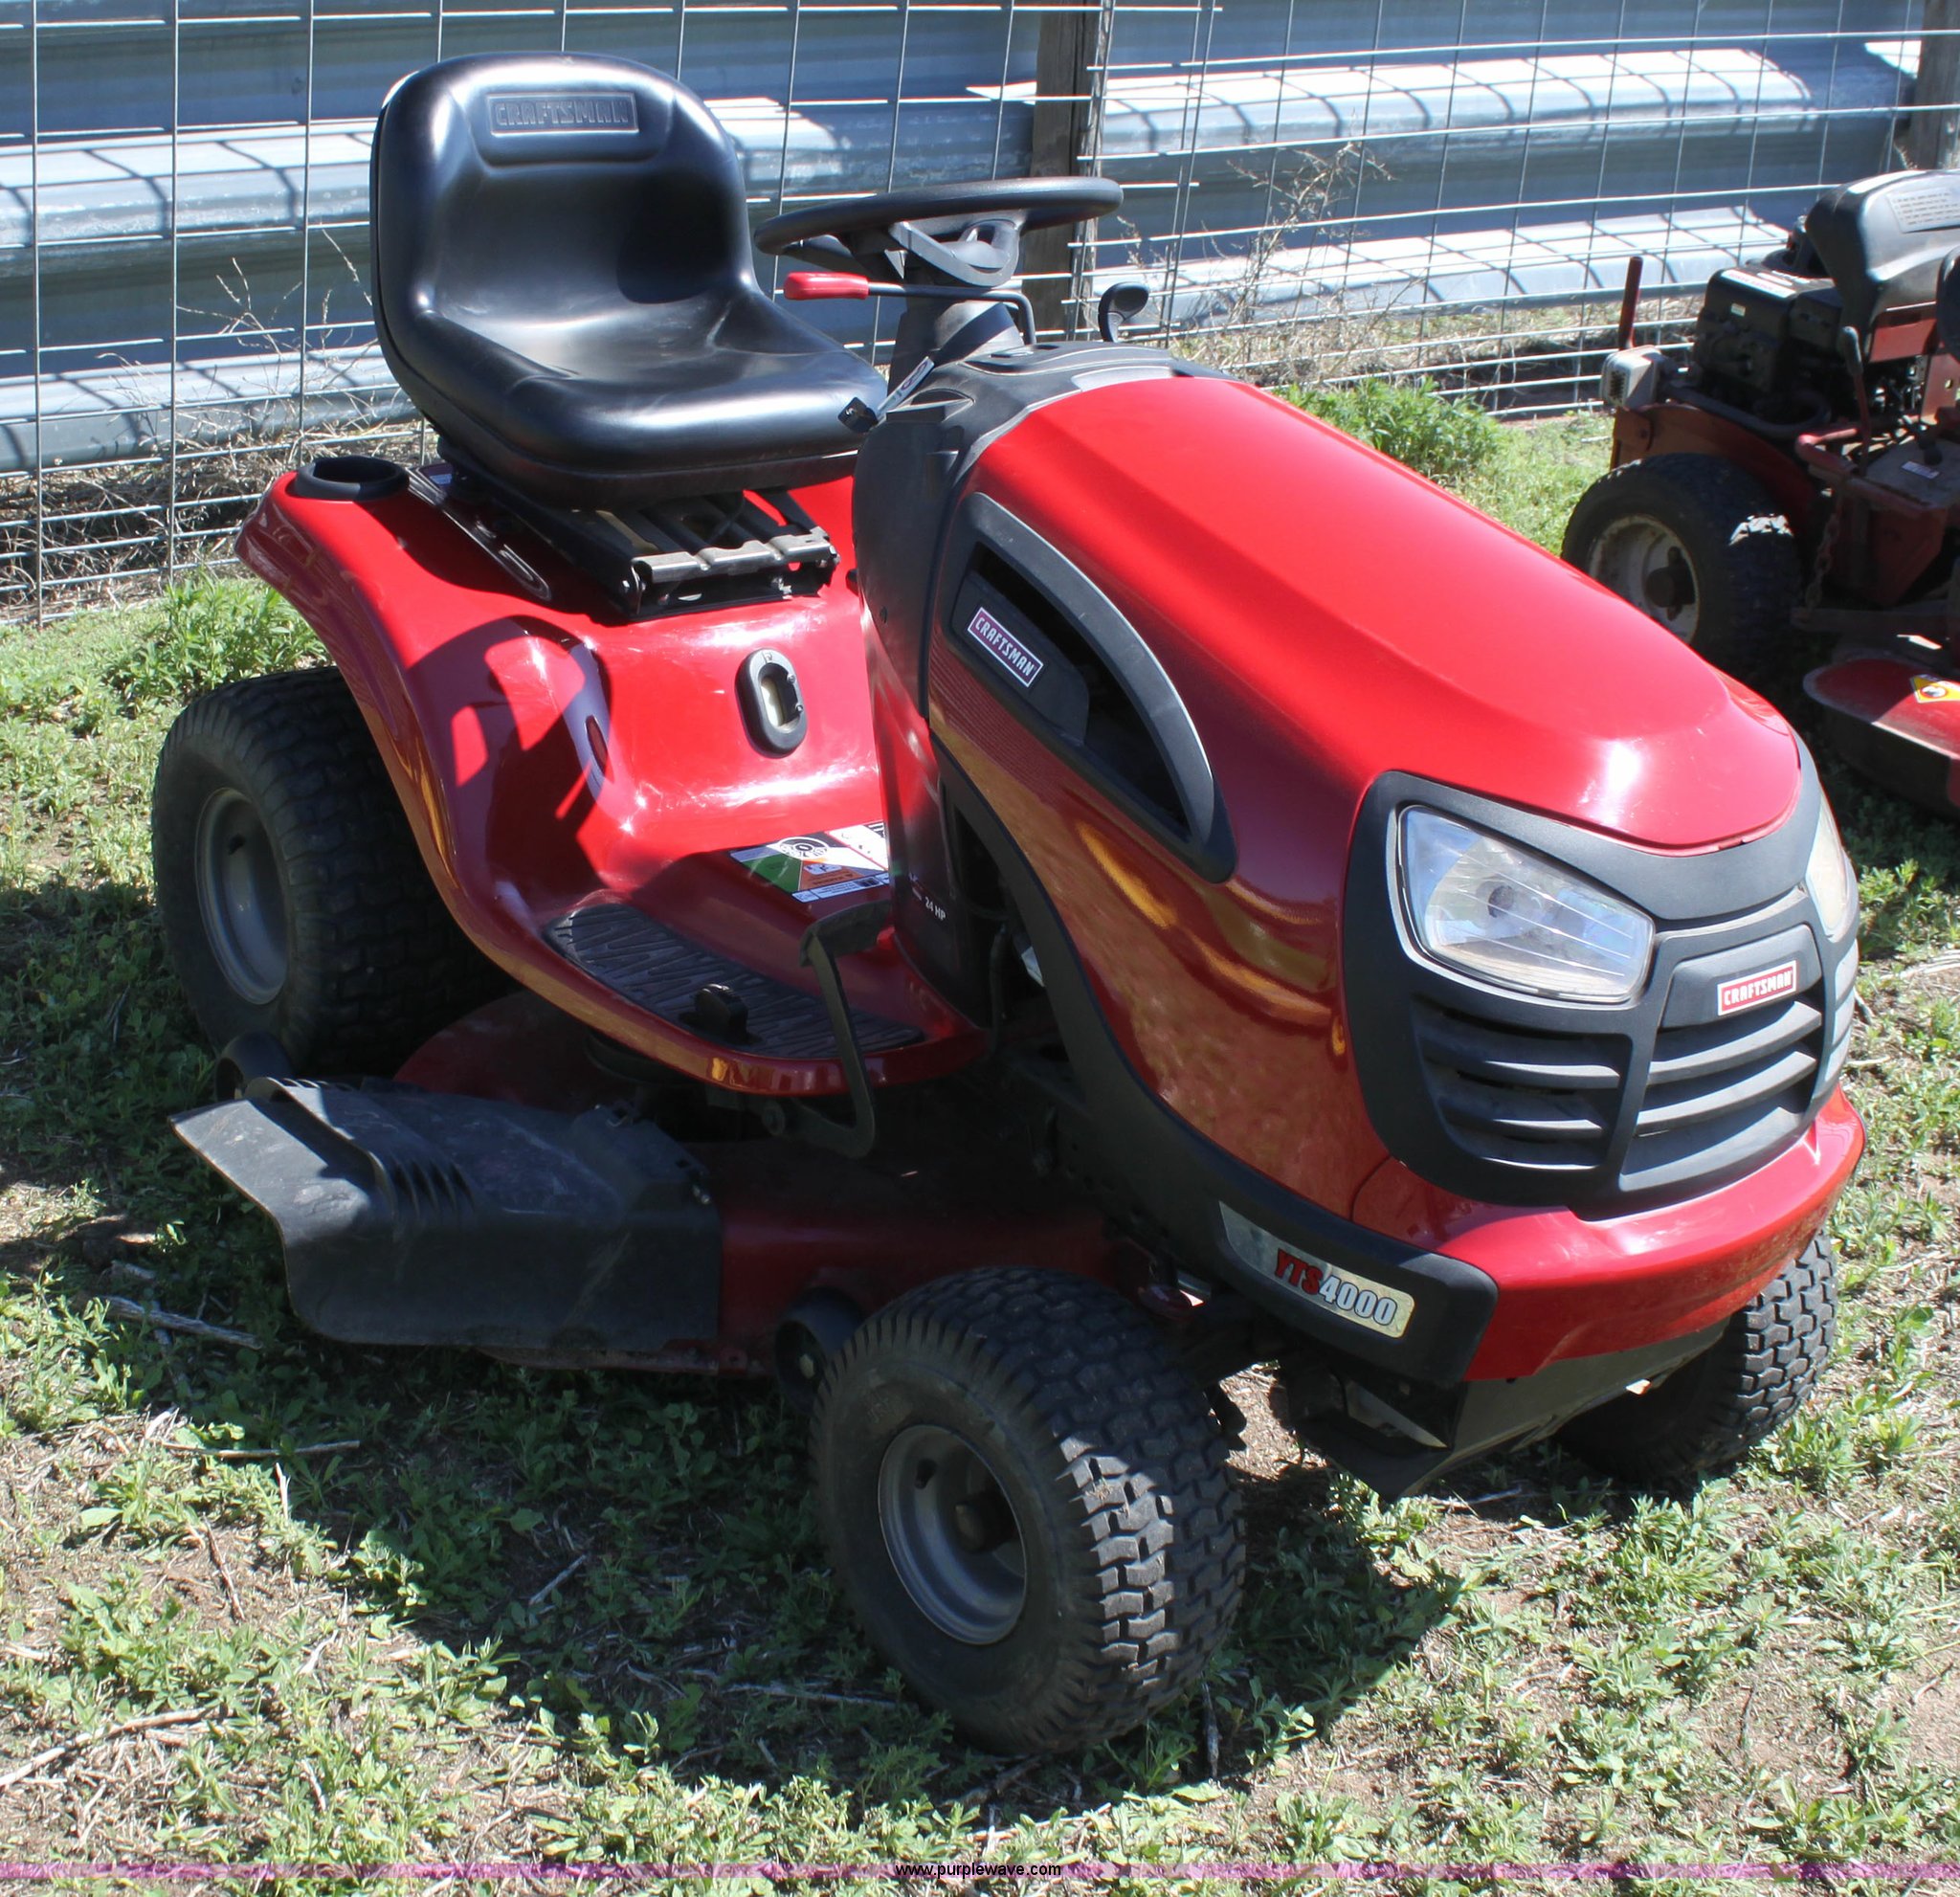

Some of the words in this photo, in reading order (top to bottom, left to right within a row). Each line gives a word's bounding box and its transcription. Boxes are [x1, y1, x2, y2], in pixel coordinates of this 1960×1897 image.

[496, 101, 629, 126] CRAFTSMAN
[975, 616, 1035, 677] CRAFTSMAN
[1724, 970, 1793, 1006] CRAFTSMAN
[1274, 1247, 1398, 1327] YTS4000
